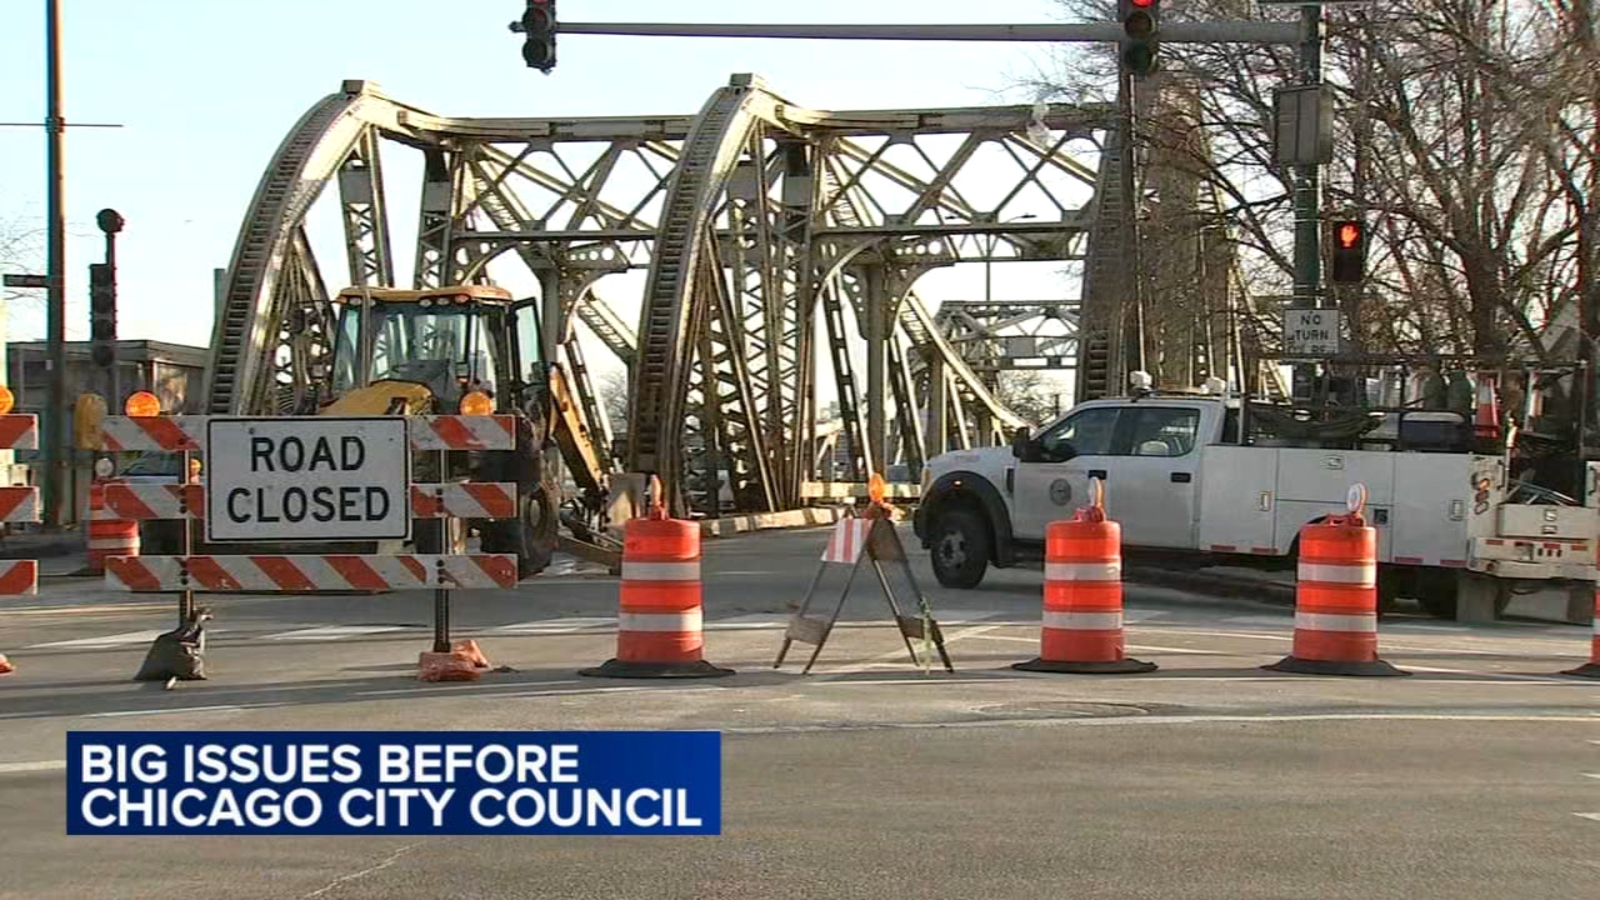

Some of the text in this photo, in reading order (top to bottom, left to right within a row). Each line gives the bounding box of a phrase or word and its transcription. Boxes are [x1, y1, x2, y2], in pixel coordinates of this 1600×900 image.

[1300, 314, 1321, 325] NO
[1295, 330, 1329, 341] TURN
[251, 436, 365, 472] ROAD
[227, 486, 390, 523] CLOSED
